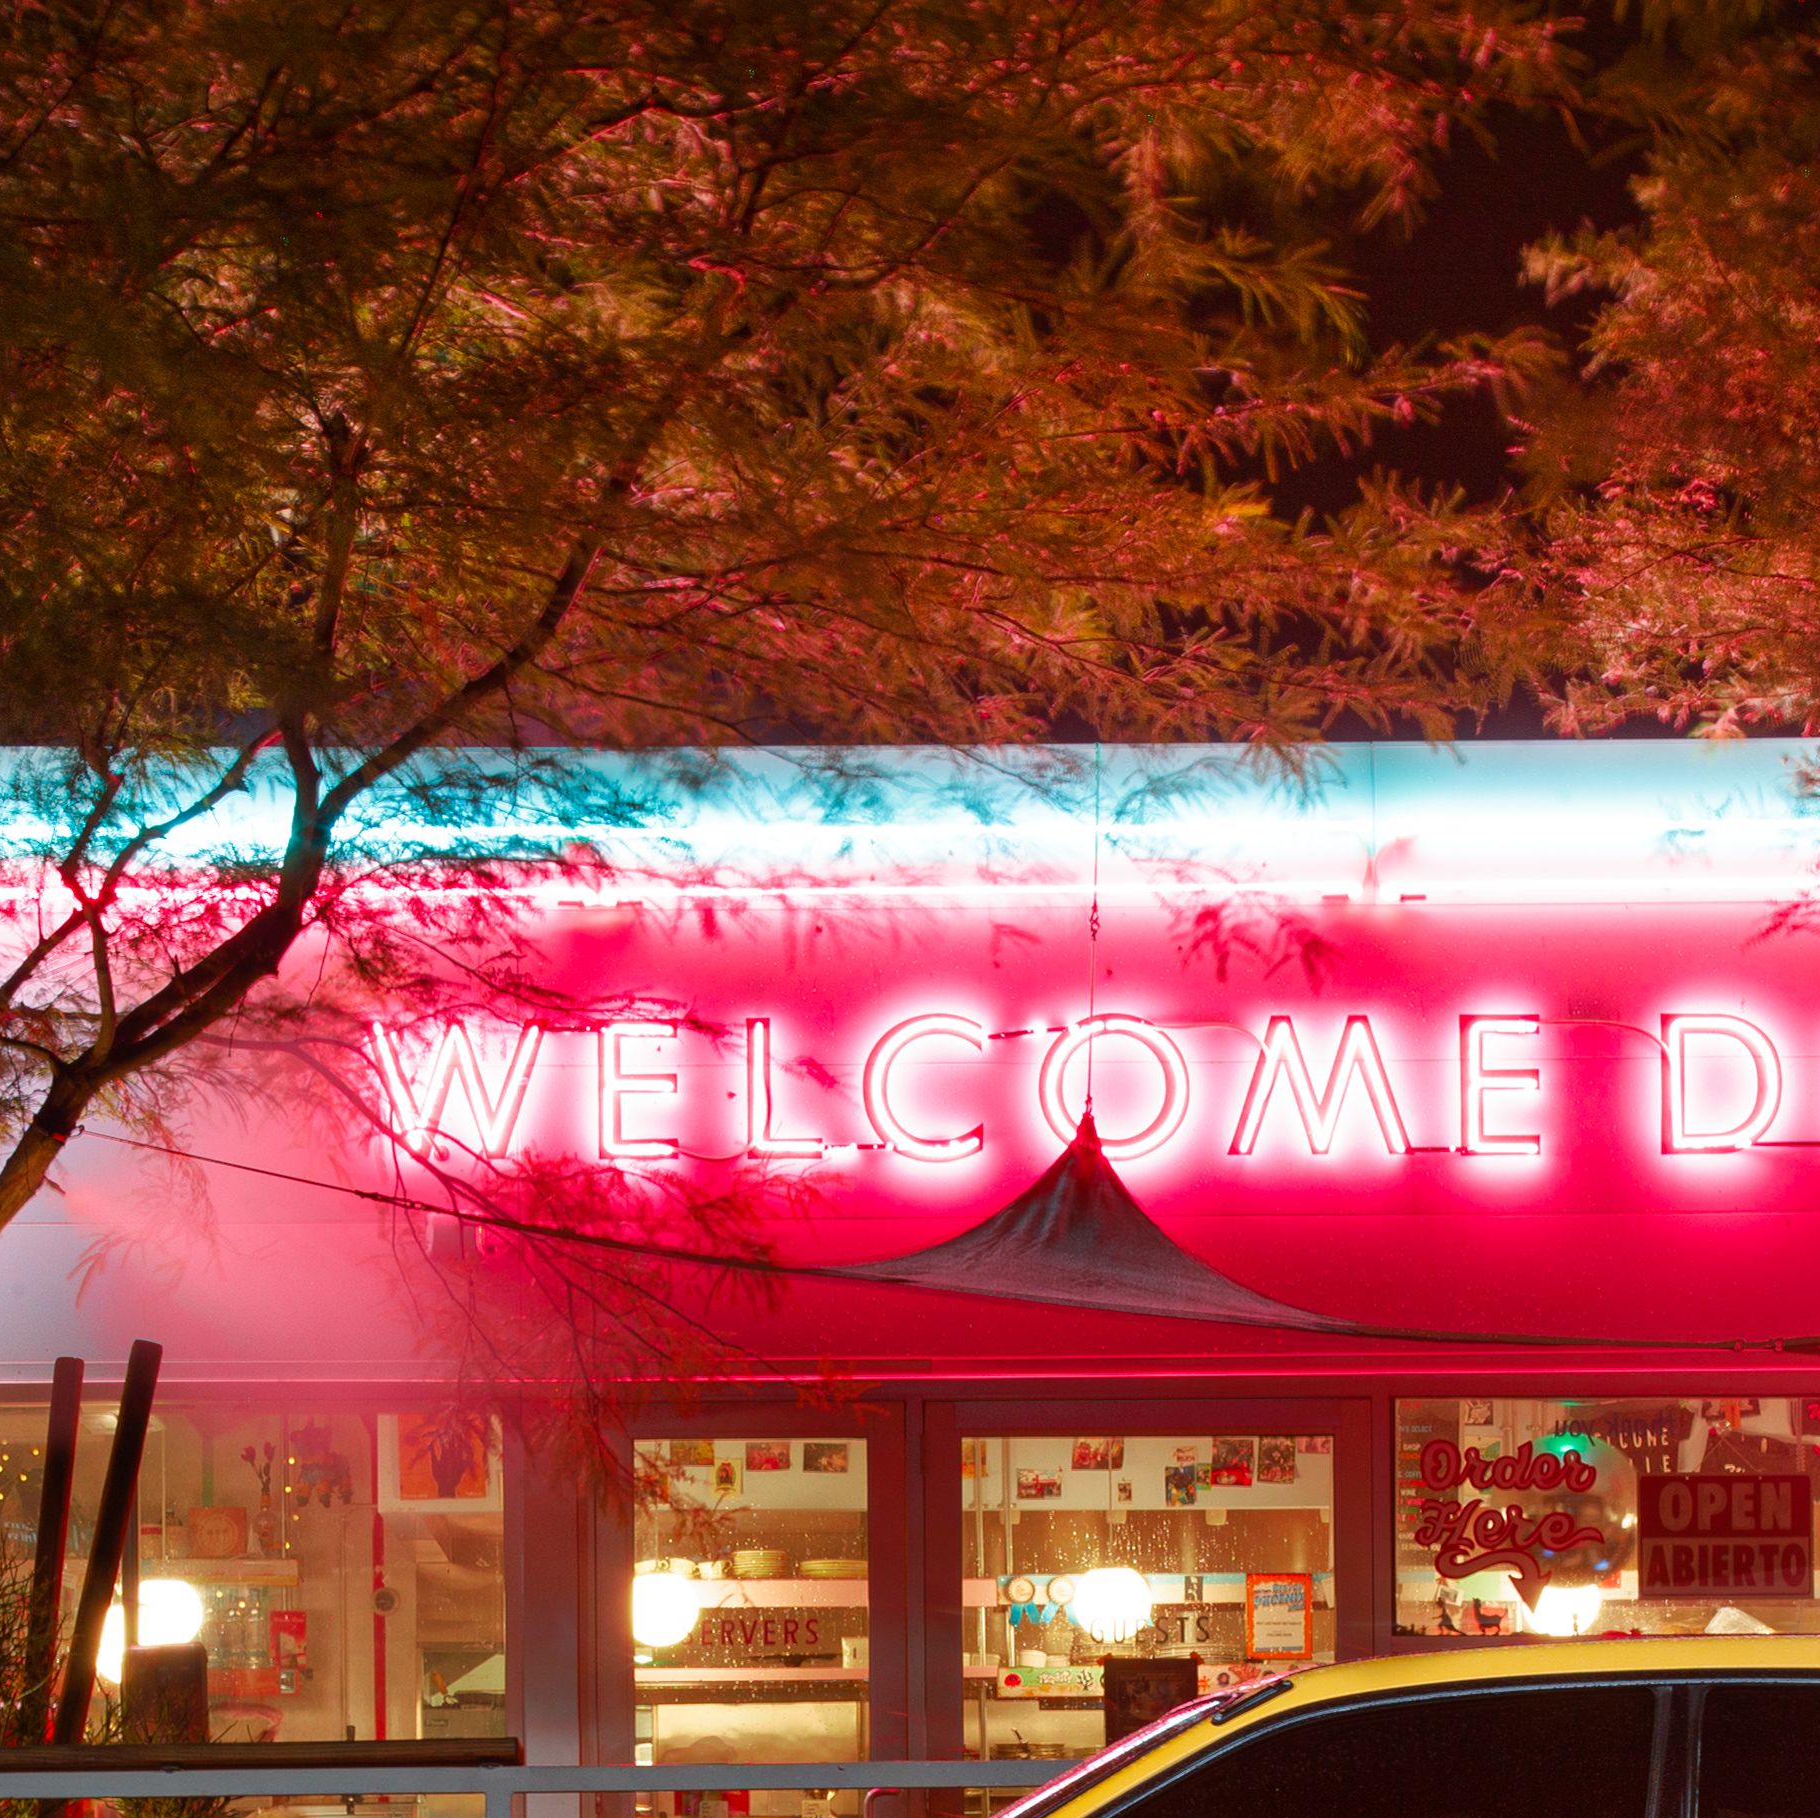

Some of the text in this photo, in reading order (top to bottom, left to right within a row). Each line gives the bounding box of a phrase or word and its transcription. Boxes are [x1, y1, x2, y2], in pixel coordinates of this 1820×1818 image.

[369, 1010, 1542, 1162] WELCOME
[1420, 1438, 1597, 1493] Order
[1414, 1498, 1606, 1552] Here
[1658, 1481, 1793, 1532] OPEN
[1645, 1543, 1808, 1589] ABIERTO
[1089, 1616, 1210, 1644] GUESTS
